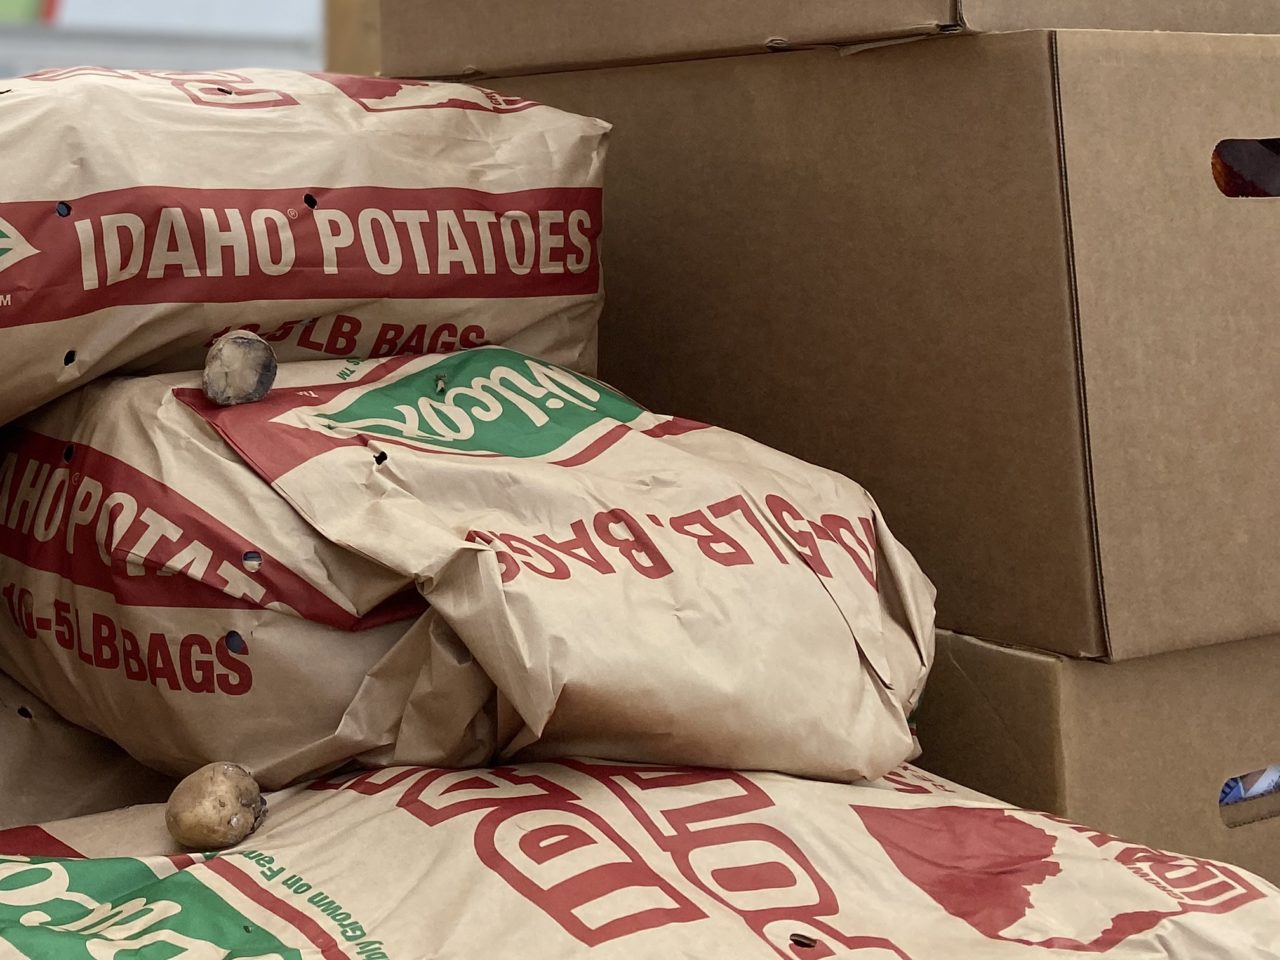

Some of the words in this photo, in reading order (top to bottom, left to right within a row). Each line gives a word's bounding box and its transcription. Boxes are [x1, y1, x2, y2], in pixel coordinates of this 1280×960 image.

[322, 208, 591, 276] POTATOES
[368, 323, 486, 359] BAGS
[66, 475, 304, 620] POTAT
[122, 628, 253, 696] BAGS
[281, 874, 313, 896] on
[307, 892, 367, 943] Grown
